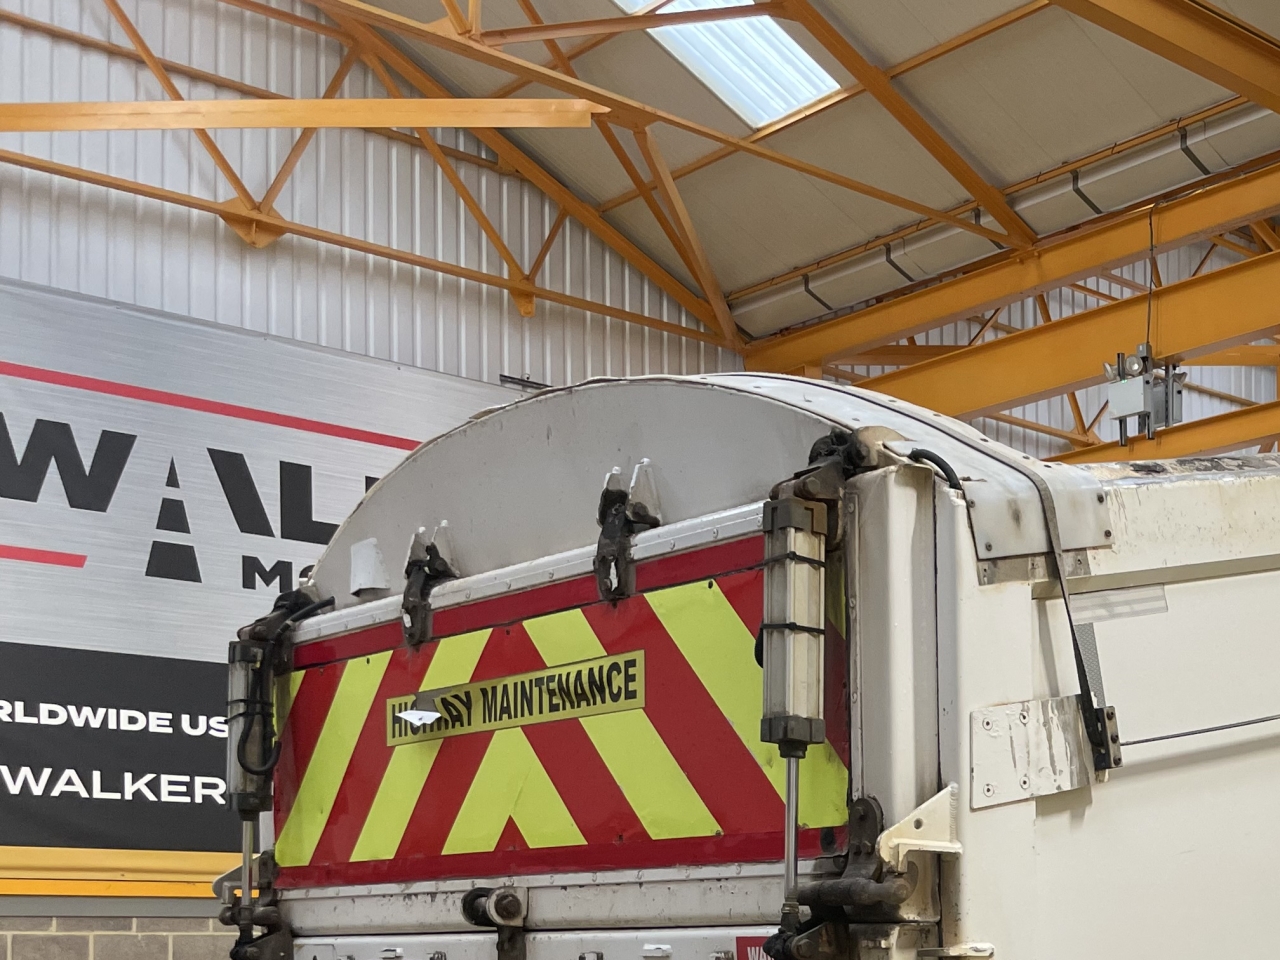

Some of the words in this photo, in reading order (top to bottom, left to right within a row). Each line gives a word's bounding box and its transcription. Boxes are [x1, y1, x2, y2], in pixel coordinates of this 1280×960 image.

[0, 410, 382, 583] WAL
[480, 659, 637, 725] MAINTENANCE
[0, 765, 227, 805] WALKER
